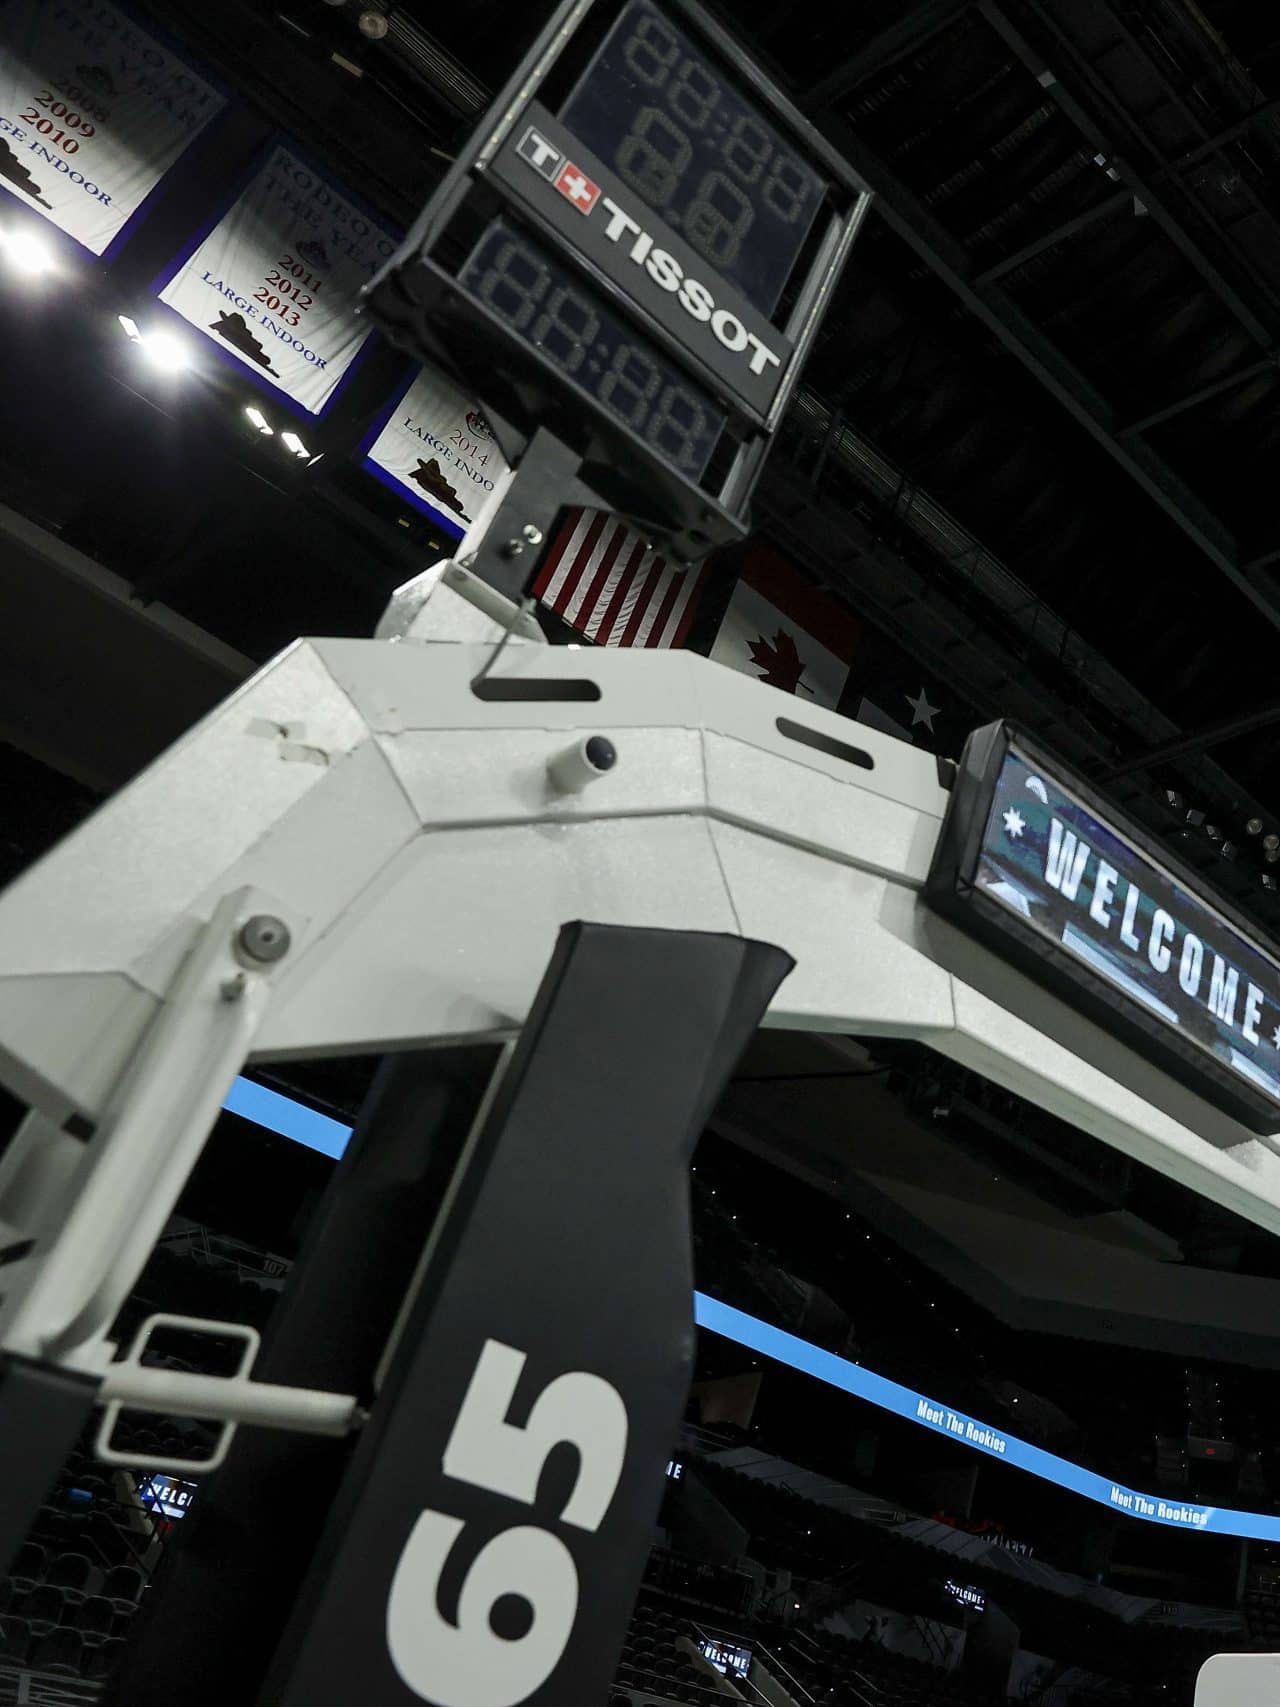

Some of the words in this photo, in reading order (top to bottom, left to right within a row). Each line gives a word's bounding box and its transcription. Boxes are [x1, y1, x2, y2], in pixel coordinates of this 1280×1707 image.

[19, 107, 79, 154] 2010
[34, 90, 96, 138] 2009
[29, 141, 112, 207] INDOOR
[265, 270, 313, 311] 2012
[279, 254, 322, 293] 2011
[602, 198, 781, 376] TISSOT
[202, 271, 258, 318] LARGE
[261, 316, 327, 370] INDOOR
[253, 286, 301, 327] 2013
[403, 416, 453, 461] LARGE
[453, 458, 495, 492] INDO
[449, 428, 489, 467] 2014
[1044, 817, 1266, 1047] WELCOME
[917, 1399, 944, 1427] Meet
[946, 1412, 965, 1436] The
[966, 1422, 1006, 1454] Rookies
[385, 1337, 630, 1707] 65
[1110, 1485, 1133, 1509] Meet
[1134, 1495, 1155, 1516] The
[1157, 1501, 1208, 1526] Rookies
